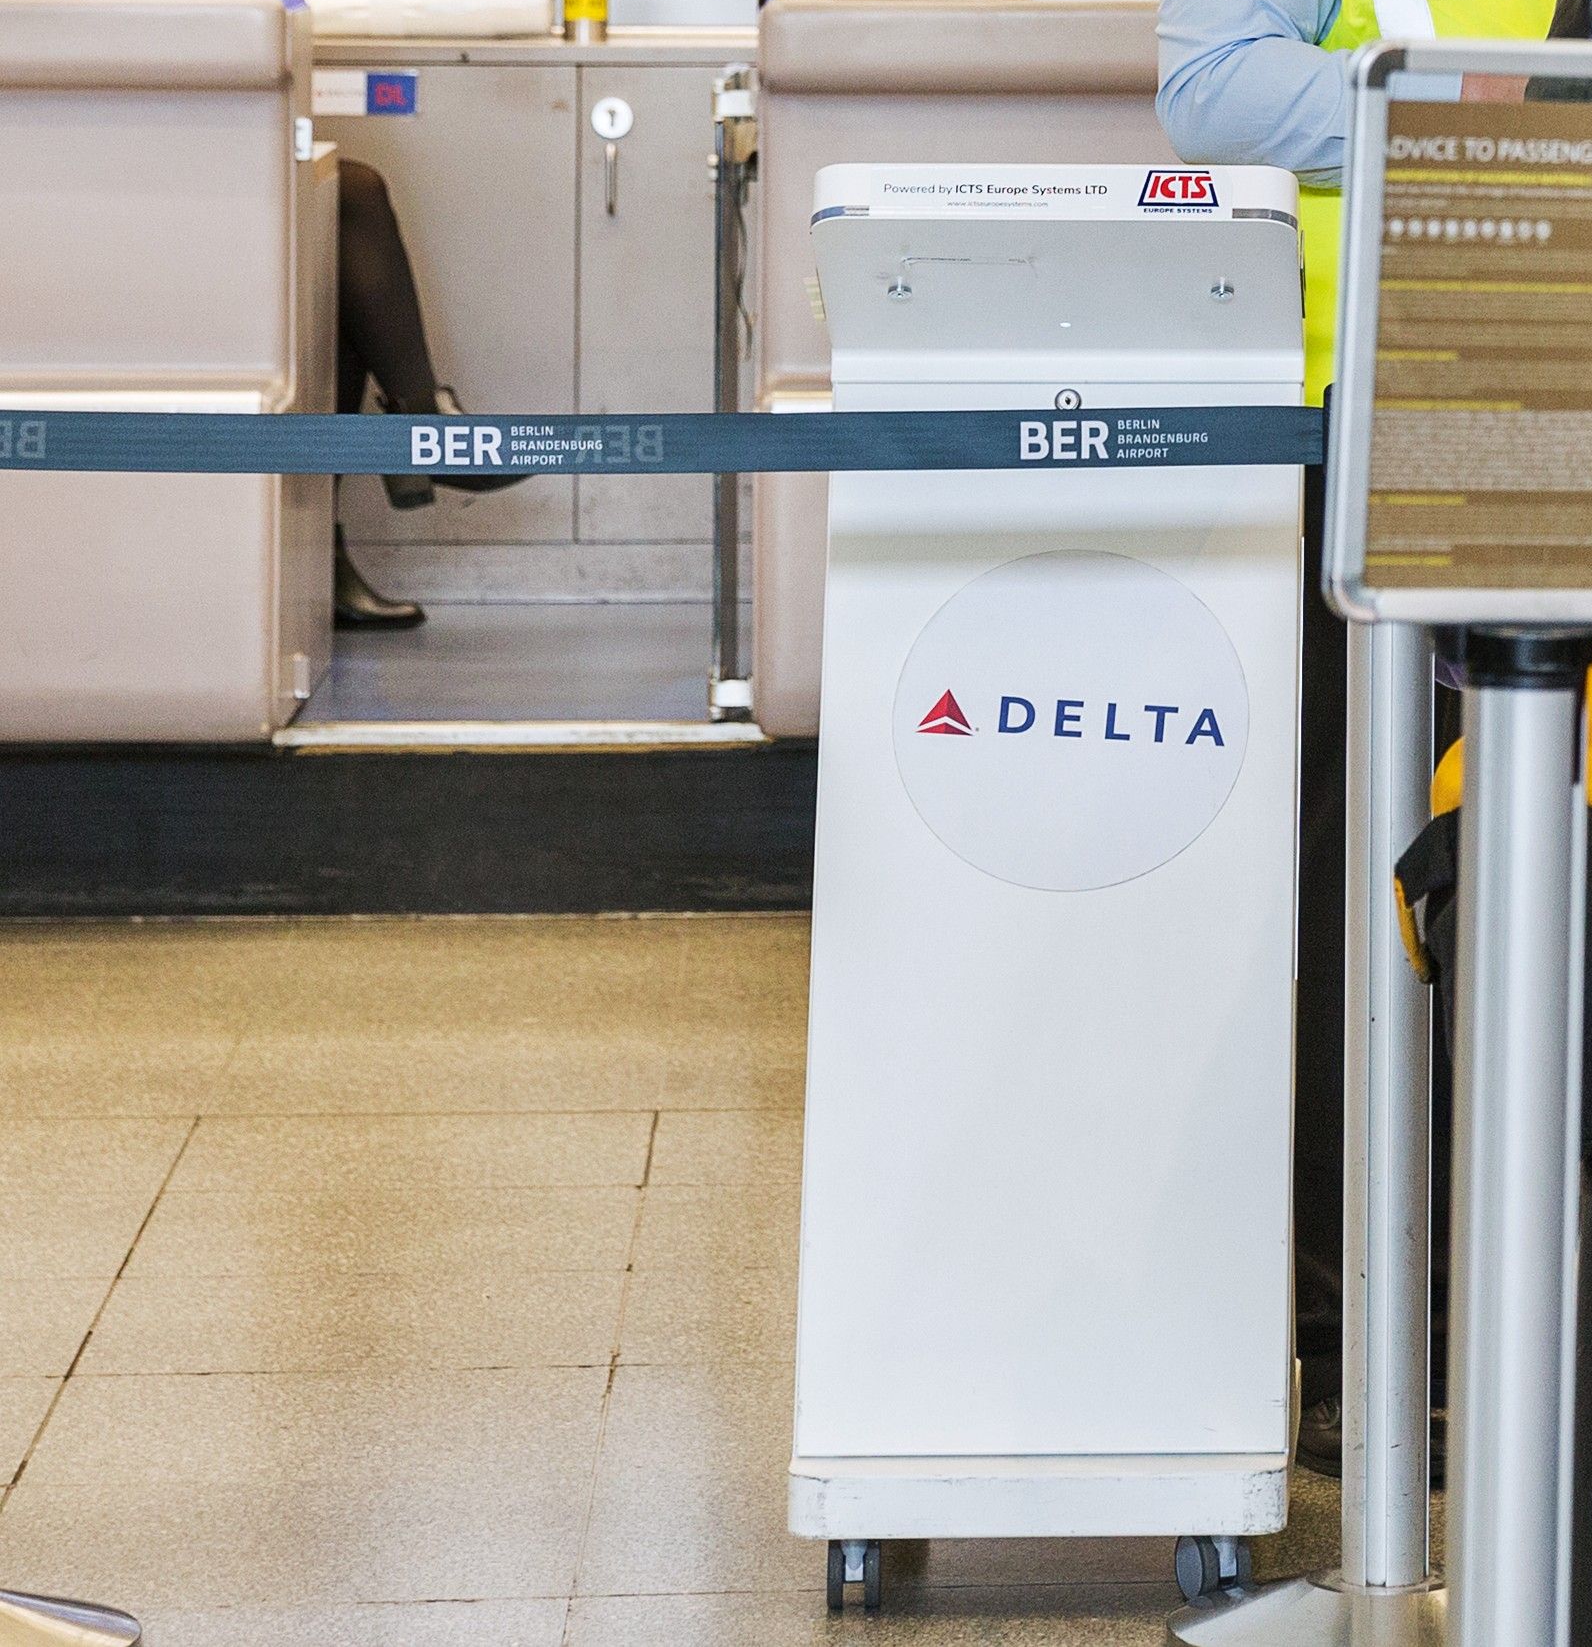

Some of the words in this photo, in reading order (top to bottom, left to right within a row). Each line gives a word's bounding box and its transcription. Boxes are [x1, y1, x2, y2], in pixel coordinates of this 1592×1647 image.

[1388, 135, 1458, 161] DVICE
[1465, 137, 1495, 162] TO
[883, 183, 935, 195] Powered
[939, 184, 953, 196] by
[955, 184, 983, 195] ICTS
[987, 184, 1028, 197] Europe
[1032, 184, 1082, 197] Systems
[1085, 185, 1108, 195] LTD
[1148, 176, 1212, 199] ICTS
[510, 425, 554, 436] BERLIN
[1117, 419, 1160, 430] BERLIN
[411, 425, 502, 465] BER
[510, 439, 603, 451] BRANDENBURG
[1020, 420, 1109, 460] BER
[1117, 432, 1208, 445] BRANDENBURG
[510, 454, 564, 465] AIRPORT
[1117, 447, 1169, 459] AIRPORT
[997, 695, 1226, 747] DELTA
